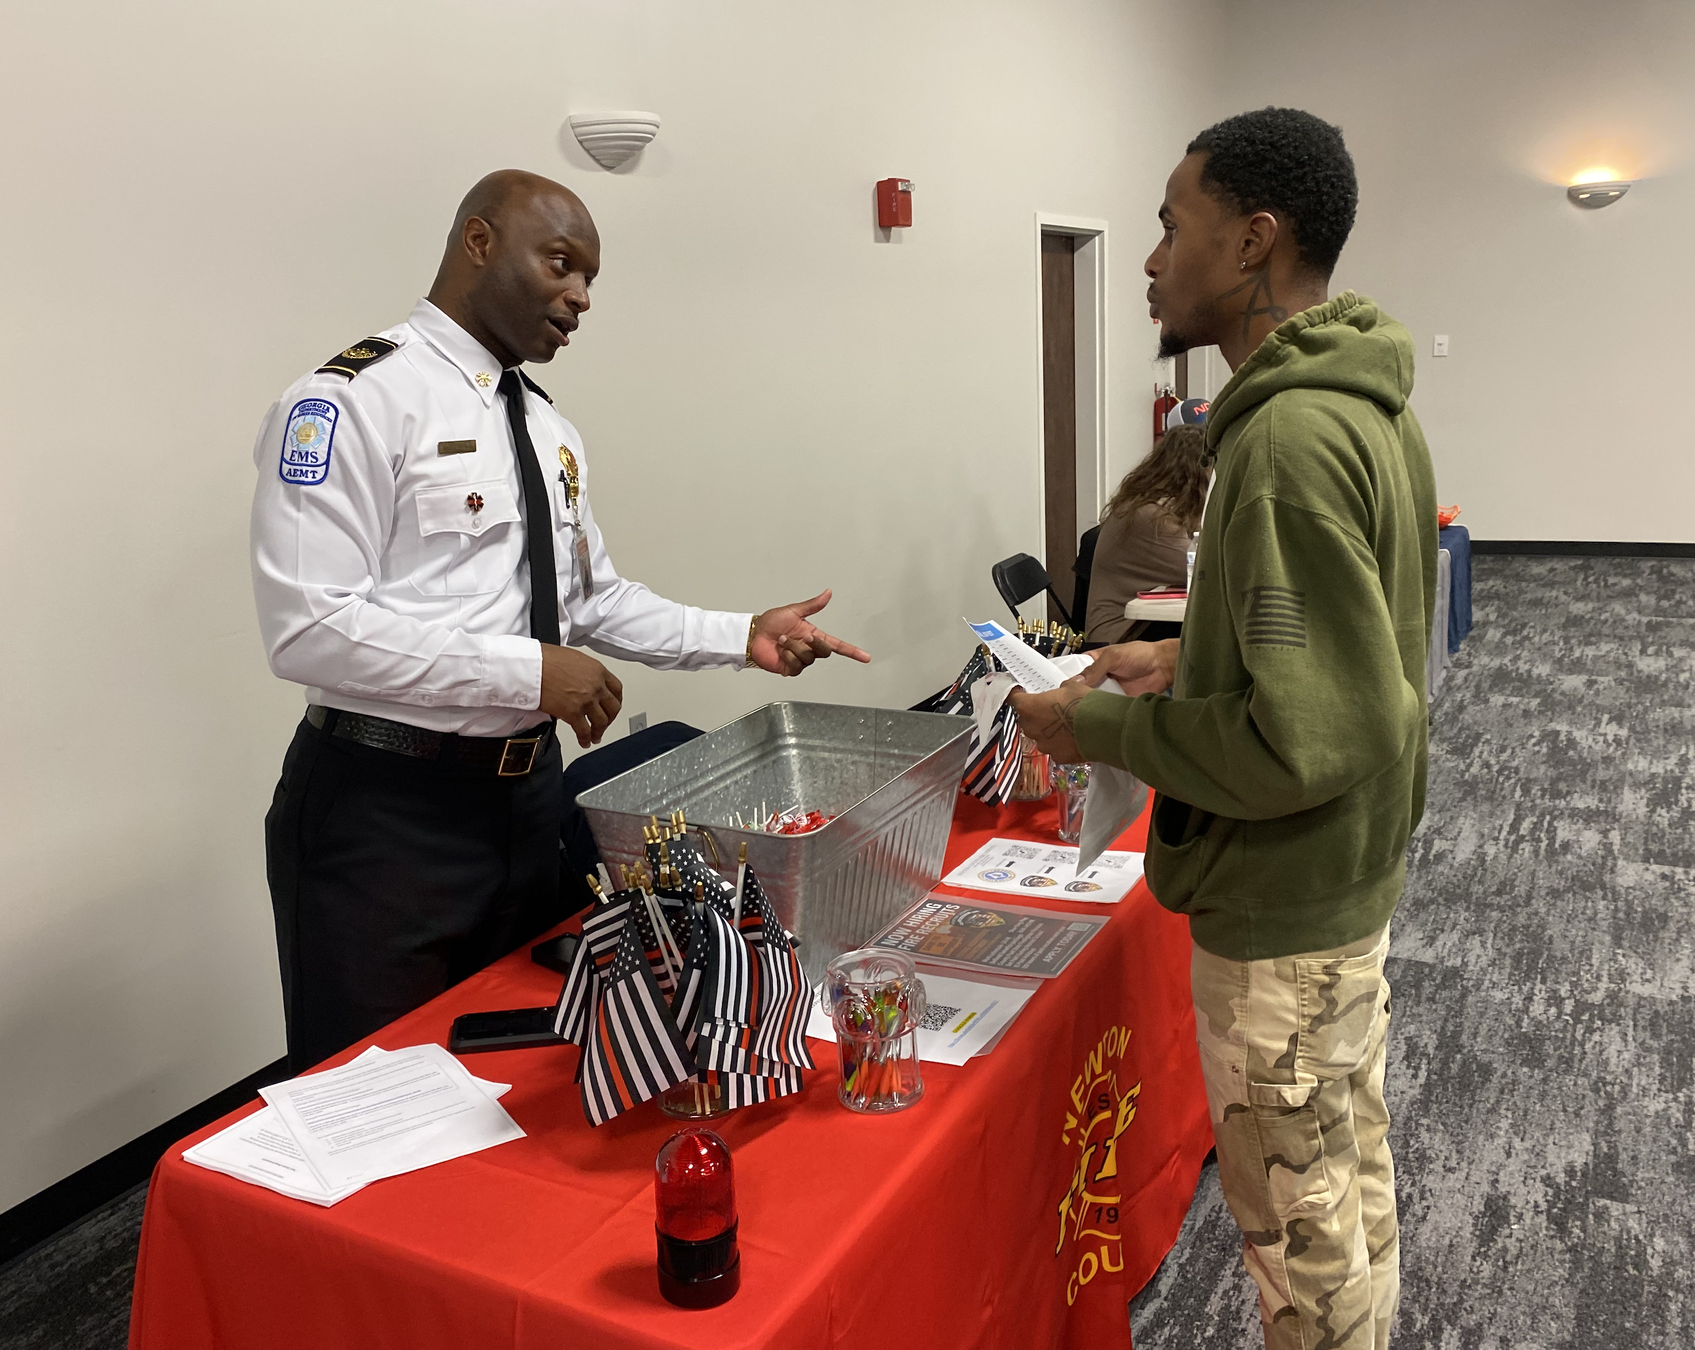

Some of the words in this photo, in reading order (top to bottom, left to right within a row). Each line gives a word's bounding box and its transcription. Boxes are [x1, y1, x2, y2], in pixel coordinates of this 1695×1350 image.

[289, 450, 319, 464] EMS
[286, 468, 318, 479] AEMT
[881, 926, 912, 946] NOW
[903, 902, 942, 927] HIRING
[897, 934, 924, 951] FIRE
[915, 904, 960, 935] RECRUITS
